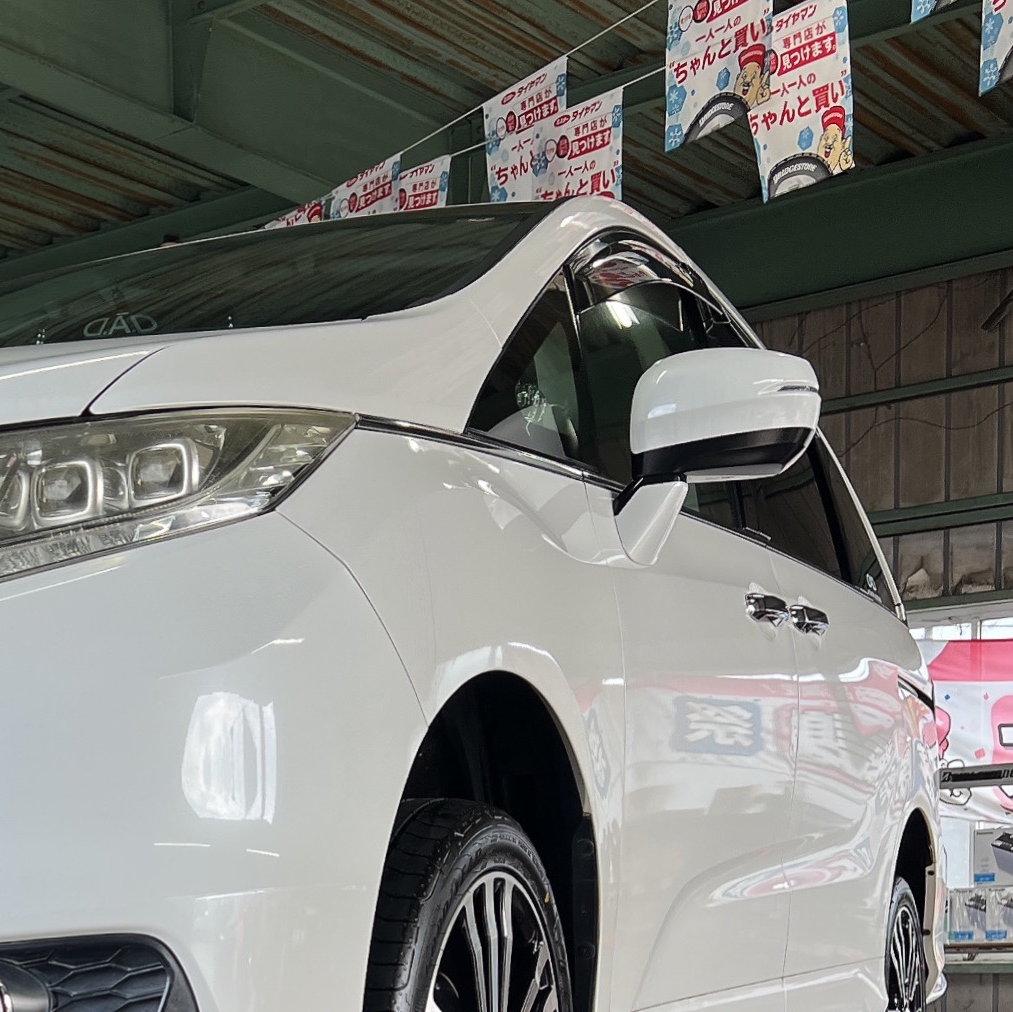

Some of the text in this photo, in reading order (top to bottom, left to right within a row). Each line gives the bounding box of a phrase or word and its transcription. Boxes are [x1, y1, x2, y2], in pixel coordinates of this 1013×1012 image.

[695, 15, 742, 43] 一人一人の
[775, 4, 817, 33] タイヤマン
[782, 22, 827, 49] 専門店が
[770, 72, 816, 97] 一人一人の
[520, 87, 553, 110] 専門店が
[574, 117, 608, 136] 専門店が
[557, 160, 596, 178] 一人一人の
[773, 163, 817, 185] BRIDGESTONE
